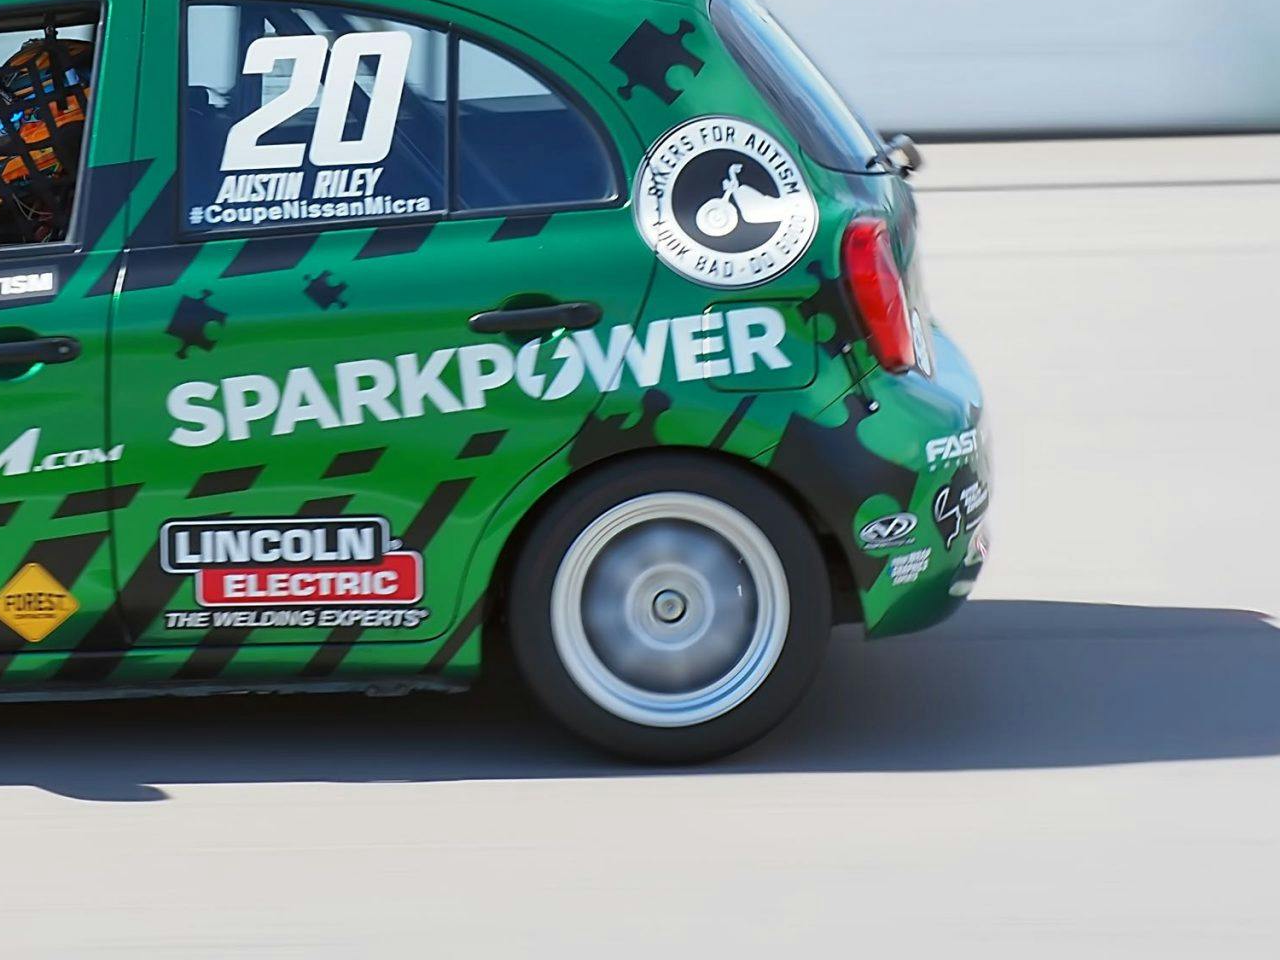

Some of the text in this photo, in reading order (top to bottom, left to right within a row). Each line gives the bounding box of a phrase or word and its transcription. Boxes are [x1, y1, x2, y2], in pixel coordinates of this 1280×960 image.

[220, 31, 412, 171] 20
[700, 125, 736, 145] FOR
[744, 133, 801, 195] AUTISM
[215, 167, 384, 203] AUSTIN RILEY
[188, 196, 431, 224] #CoupeNissanMicra
[167, 306, 792, 447] SPARKPOWER
[175, 527, 375, 564] LINCOLN
[223, 570, 399, 598] ELECTRIC
[165, 609, 422, 628] THE WELDING EXPERTS
